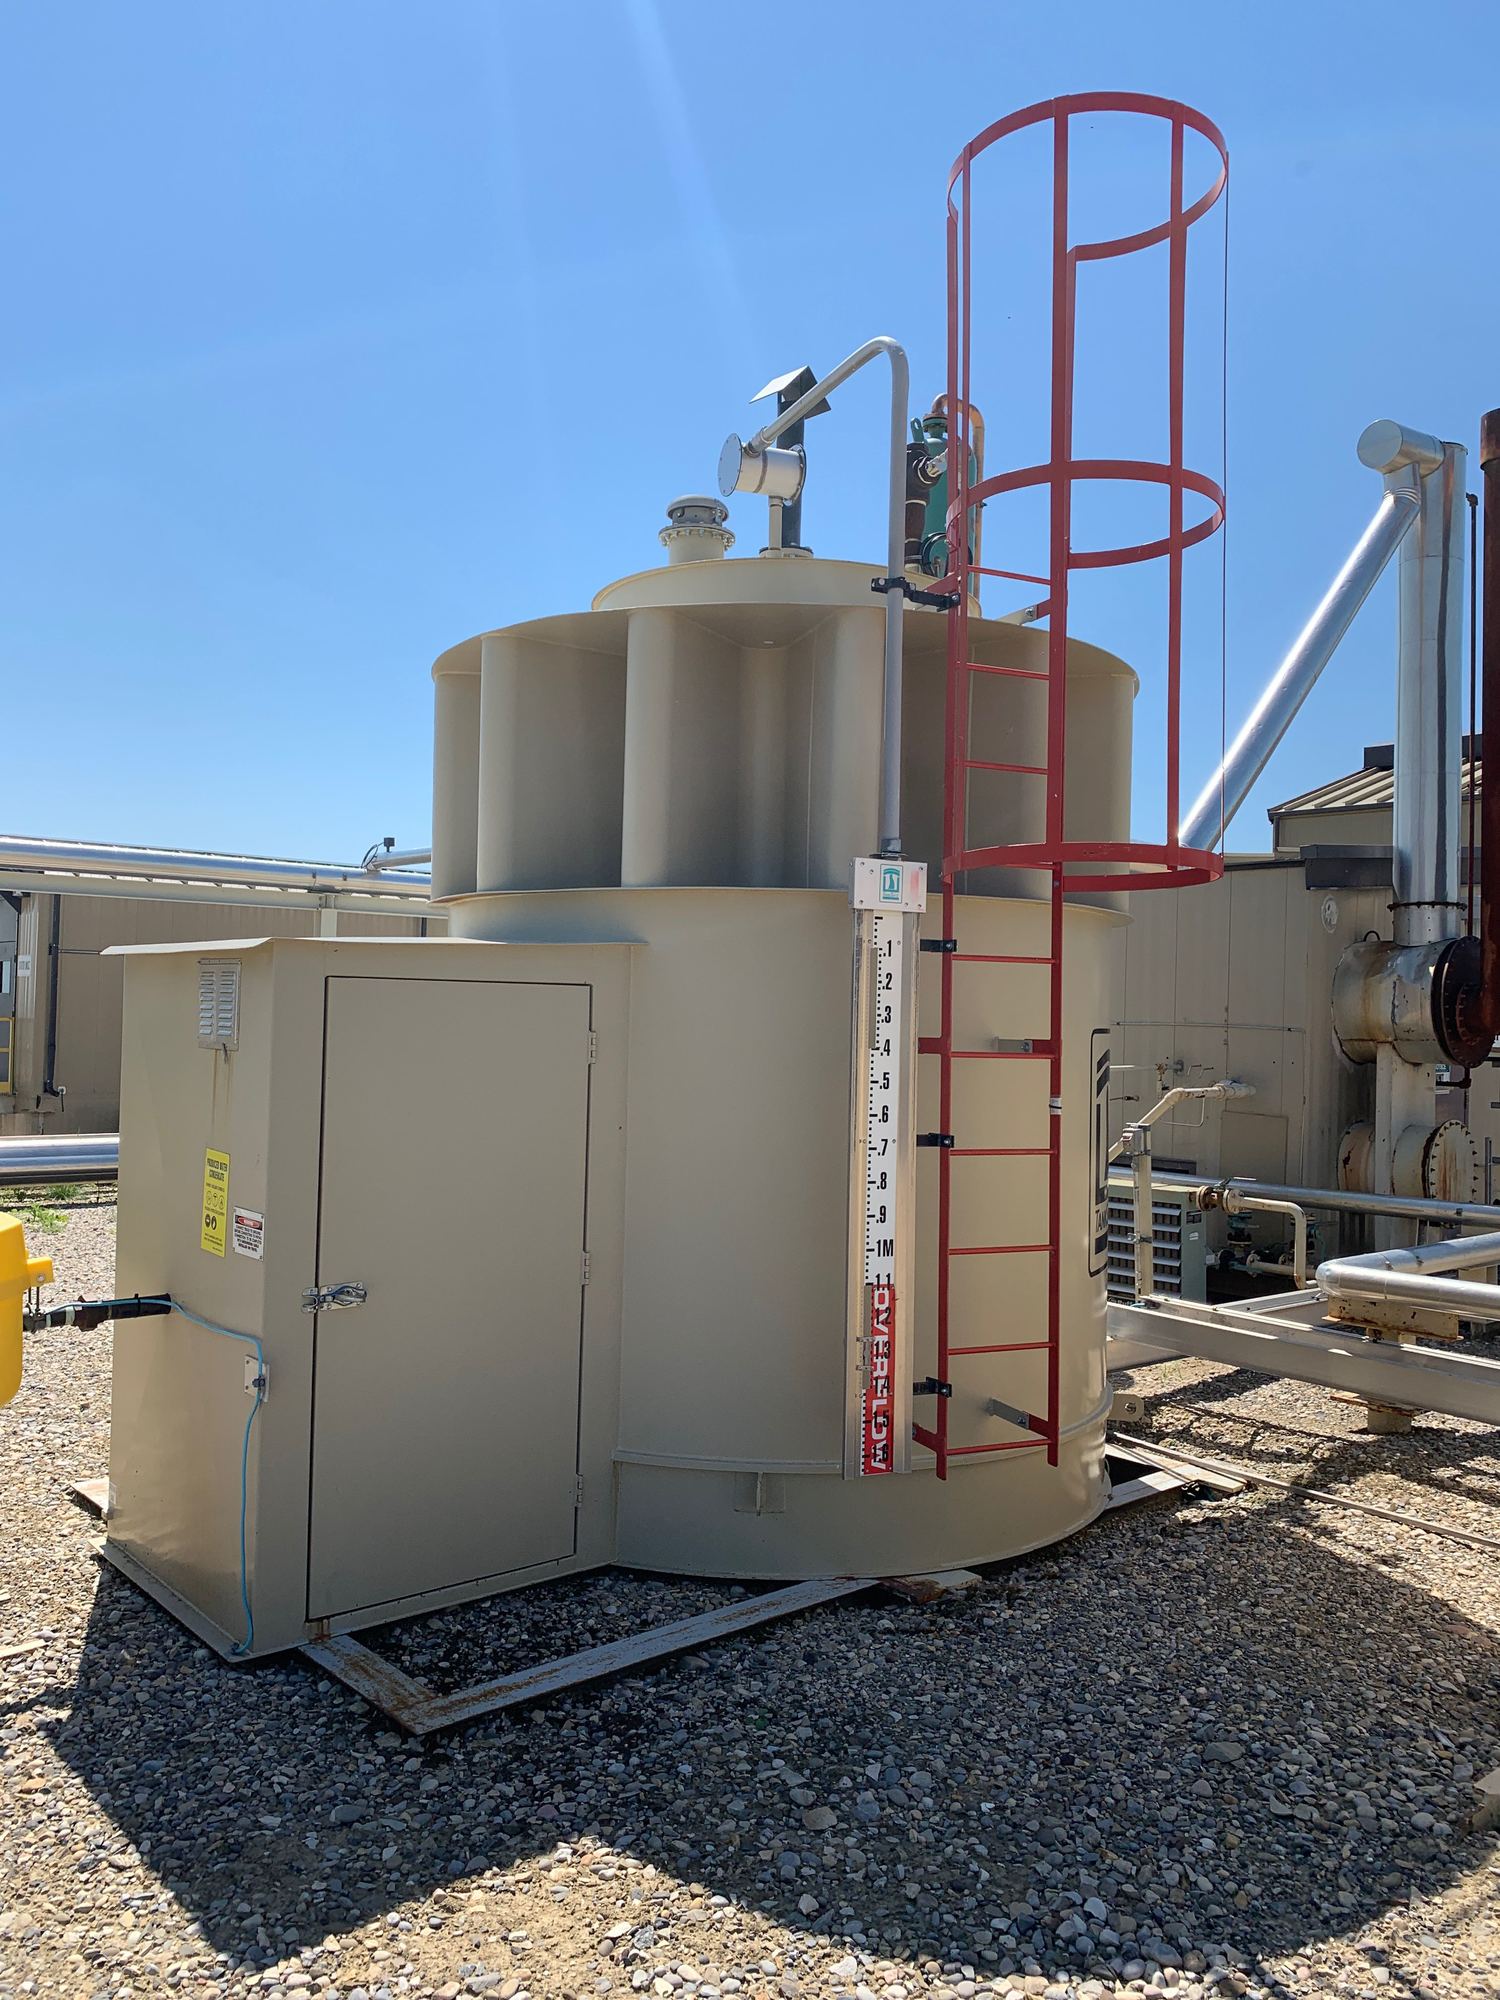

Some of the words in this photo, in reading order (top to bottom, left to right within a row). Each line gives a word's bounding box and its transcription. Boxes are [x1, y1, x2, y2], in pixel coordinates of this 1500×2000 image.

[883, 940, 892, 957] .1
[882, 973, 893, 990] .2
[881, 1006, 892, 1023] .3
[880, 1039, 891, 1056] .4
[879, 1072, 890, 1089] .5
[878, 1105, 889, 1123] .6
[877, 1138, 888, 1156] .7
[877, 1172, 887, 1190] .8
[876, 1205, 887, 1223] .9
[876, 1239, 894, 1257] 1M
